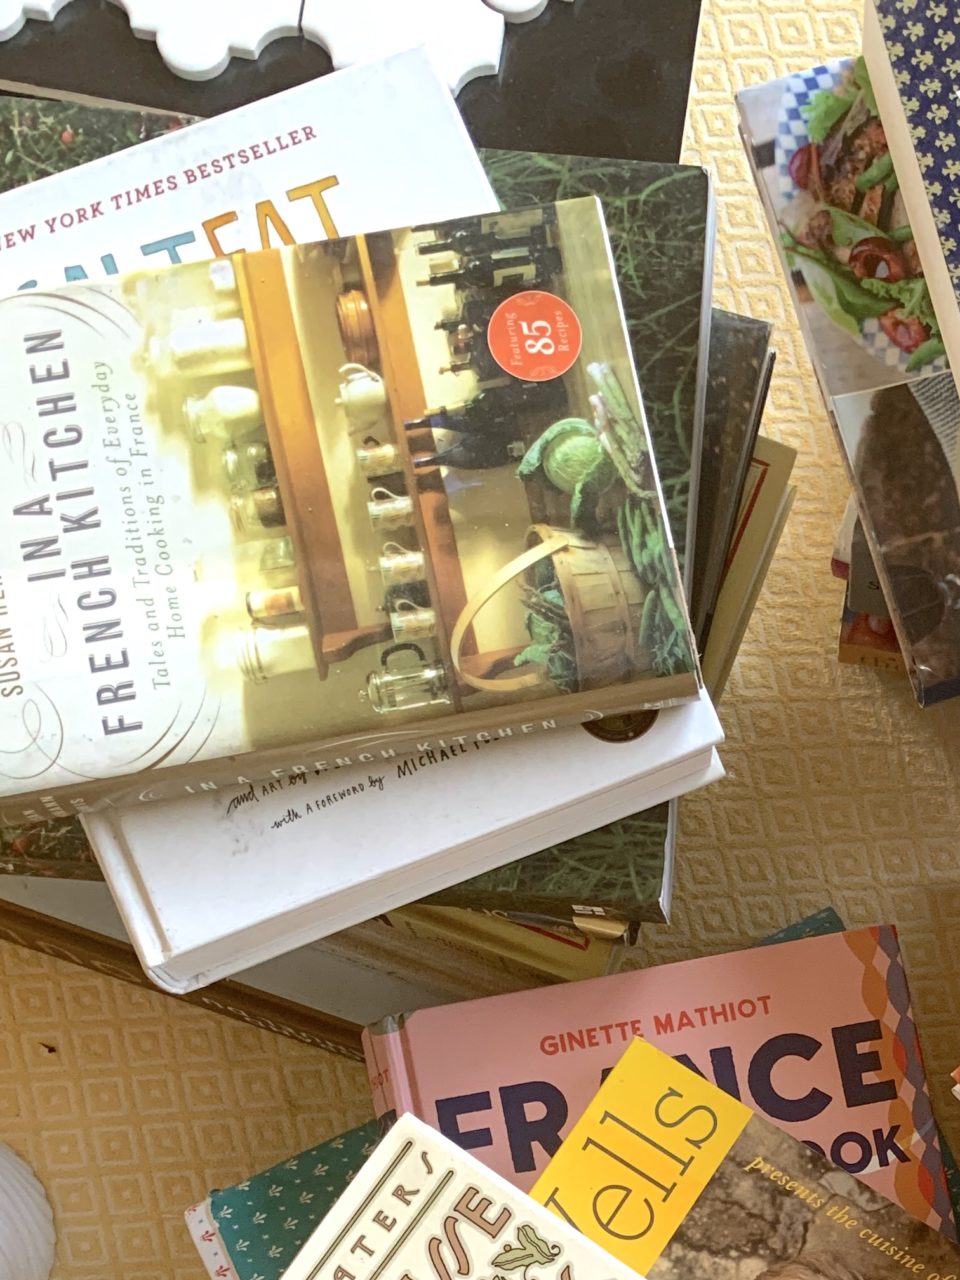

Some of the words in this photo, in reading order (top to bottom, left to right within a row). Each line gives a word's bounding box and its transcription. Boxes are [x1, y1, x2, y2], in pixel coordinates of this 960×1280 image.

[45, 201, 104, 234] YORK
[111, 174, 178, 211] TIMES
[184, 125, 317, 184] BESTSELLER
[505, 312, 523, 366] Featuring
[519, 320, 555, 356] 85
[554, 311, 570, 352] Recipes
[23, 329, 102, 534] KITCHEN
[91, 361, 121, 449] Everyday
[124, 392, 148, 458] France
[106, 456, 131, 477] of
[138, 467, 153, 486] in
[12, 494, 53, 517] A
[119, 485, 151, 588] Traditions
[146, 494, 174, 577] Cooking
[20, 535, 66, 583] IN
[135, 597, 160, 631] and
[165, 586, 186, 640] Home
[70, 555, 143, 737] FRENCH
[148, 640, 171, 690] Tales
[184, 780, 219, 794] IN
[271, 747, 397, 779] FRENCH
[417, 718, 558, 752] KITCHEN
[226, 787, 259, 816] and
[261, 779, 284, 798] ART
[270, 811, 302, 831] with
[305, 803, 314, 816] A
[314, 782, 366, 810] FOREWORD
[368, 775, 386, 791] by
[396, 744, 469, 781] MICHAEL
[539, 1019, 645, 1056] GINETTE
[654, 994, 772, 1037] MATHIOT
[434, 1018, 899, 1173] FRNCE
[744, 1154, 826, 1210] presents
[824, 1203, 859, 1230] the
[858, 1226, 928, 1275] cuisine
